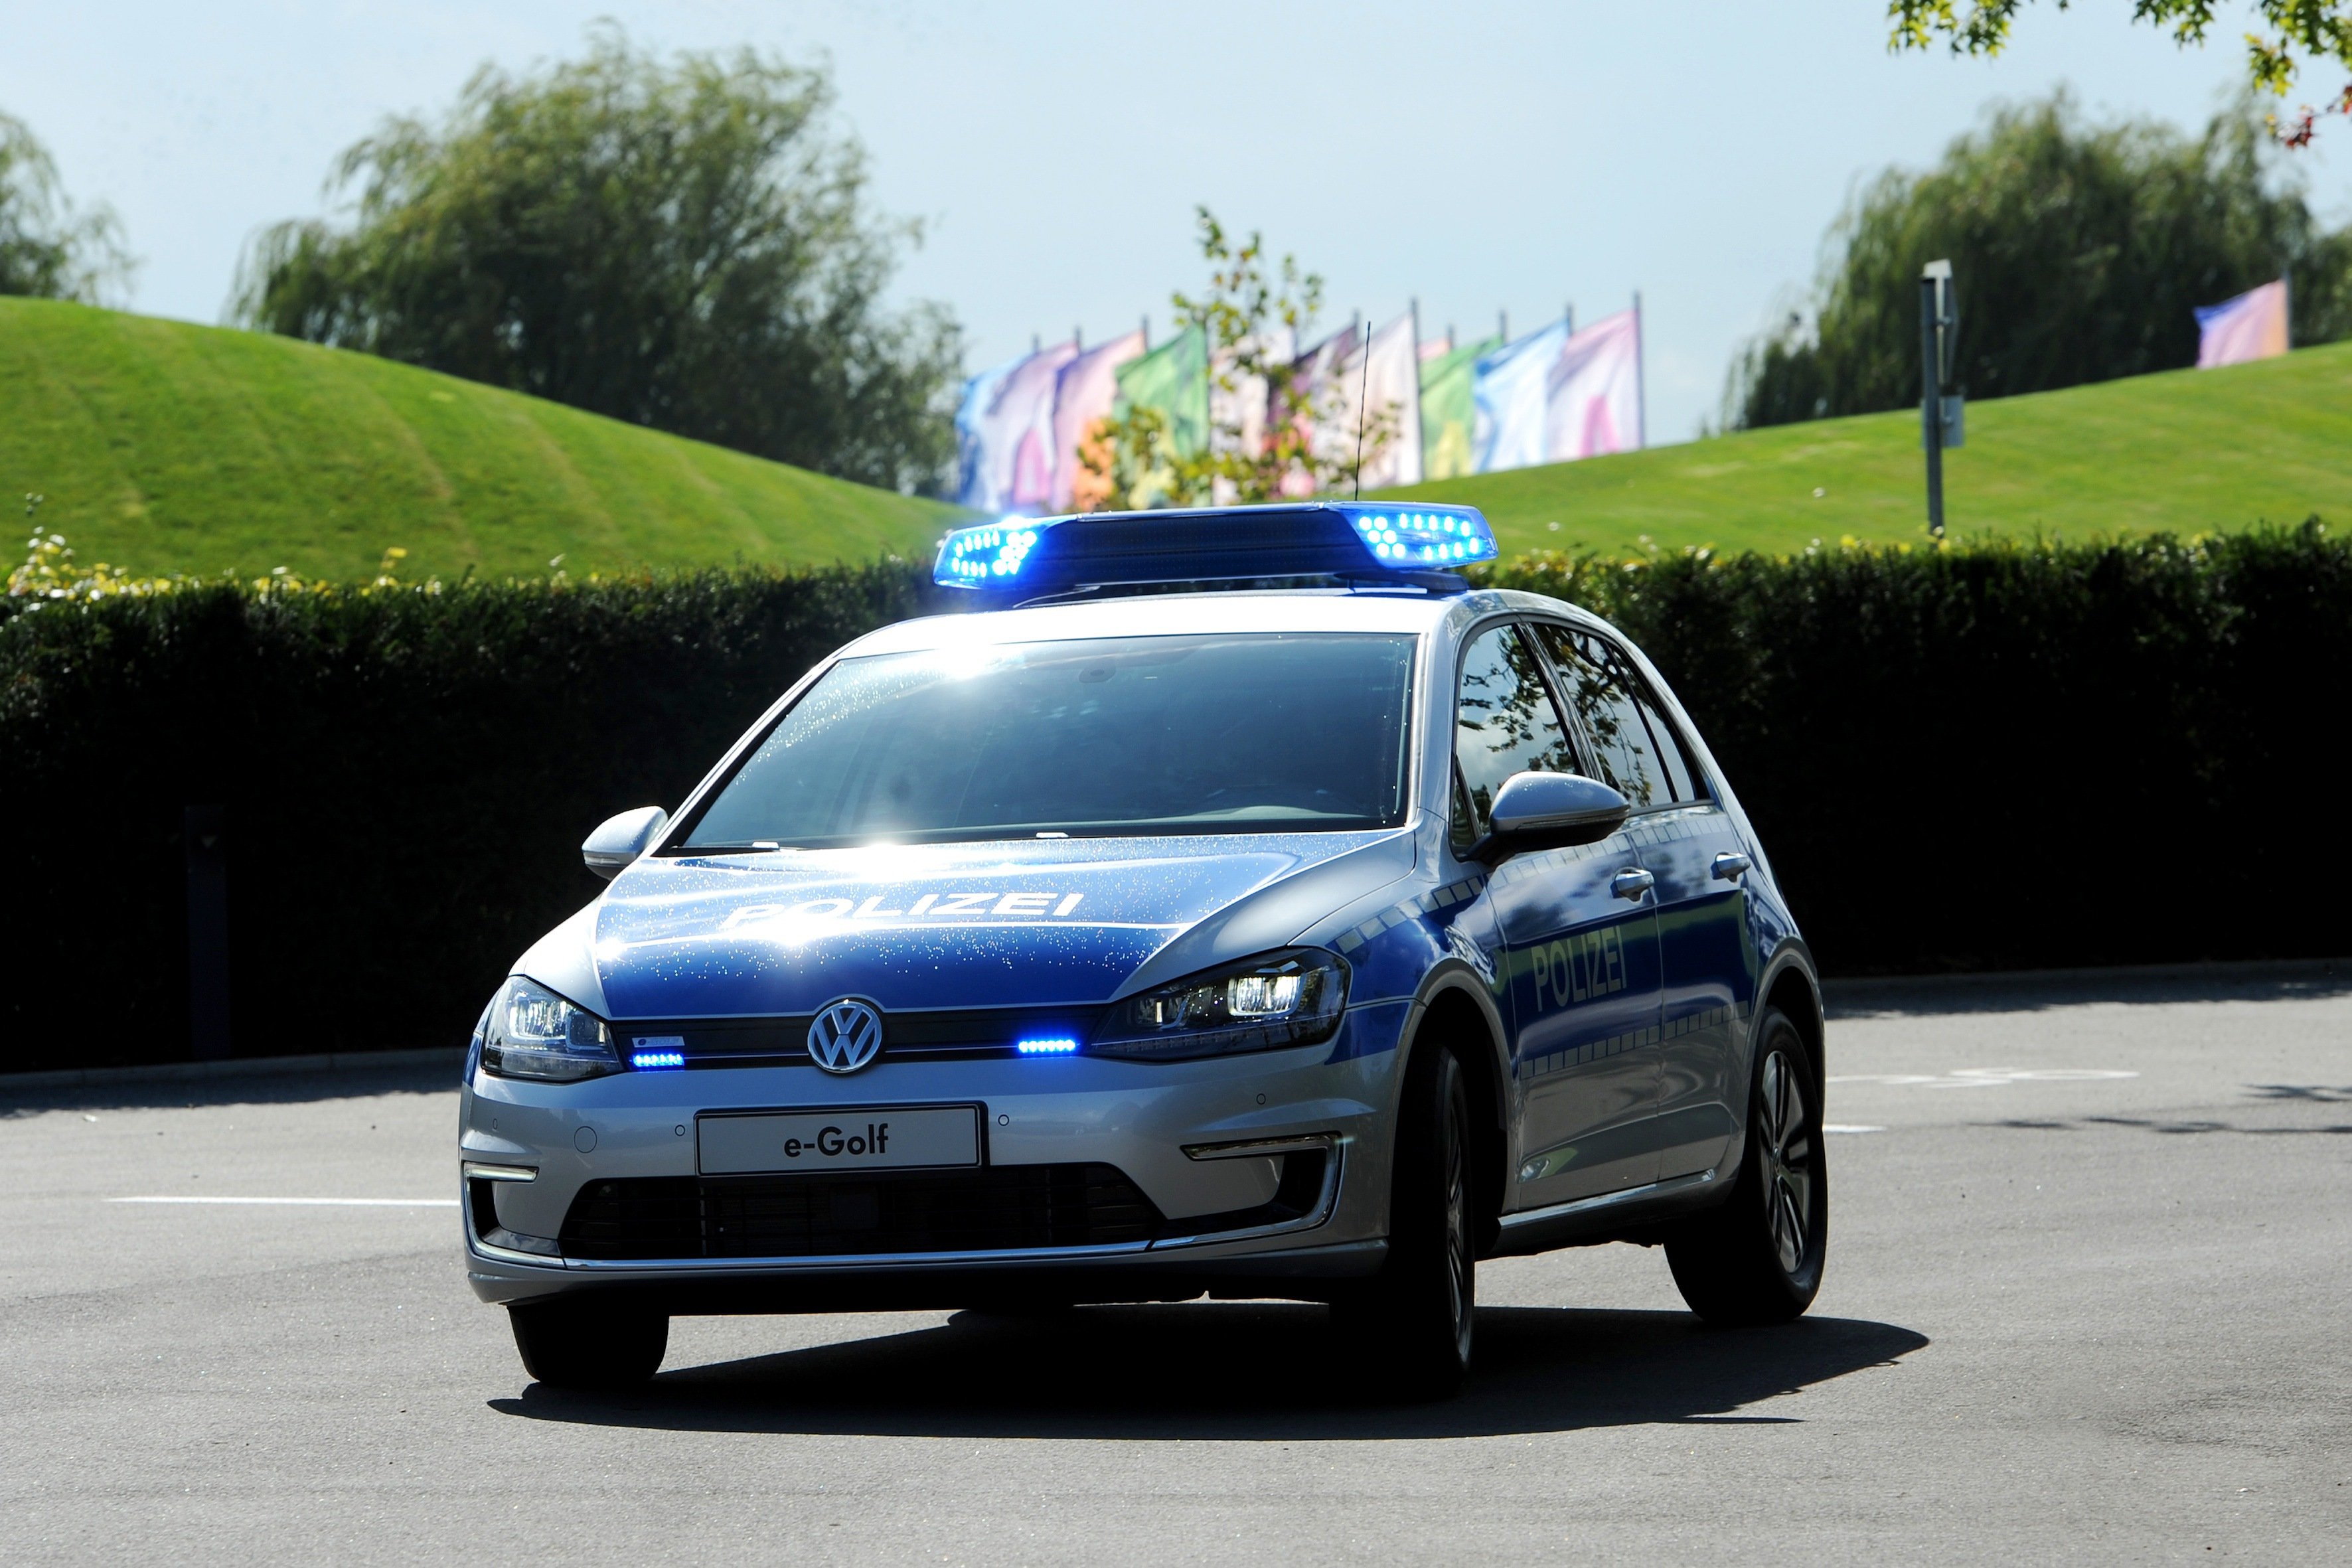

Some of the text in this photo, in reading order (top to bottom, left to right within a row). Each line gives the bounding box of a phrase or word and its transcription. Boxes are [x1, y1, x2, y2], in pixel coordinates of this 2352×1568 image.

[718, 892, 1085, 929] POLIZEI
[1531, 925, 1626, 1012] POLIZEI
[811, 1004, 880, 1069] VW
[784, 1123, 889, 1157] e-Golf
